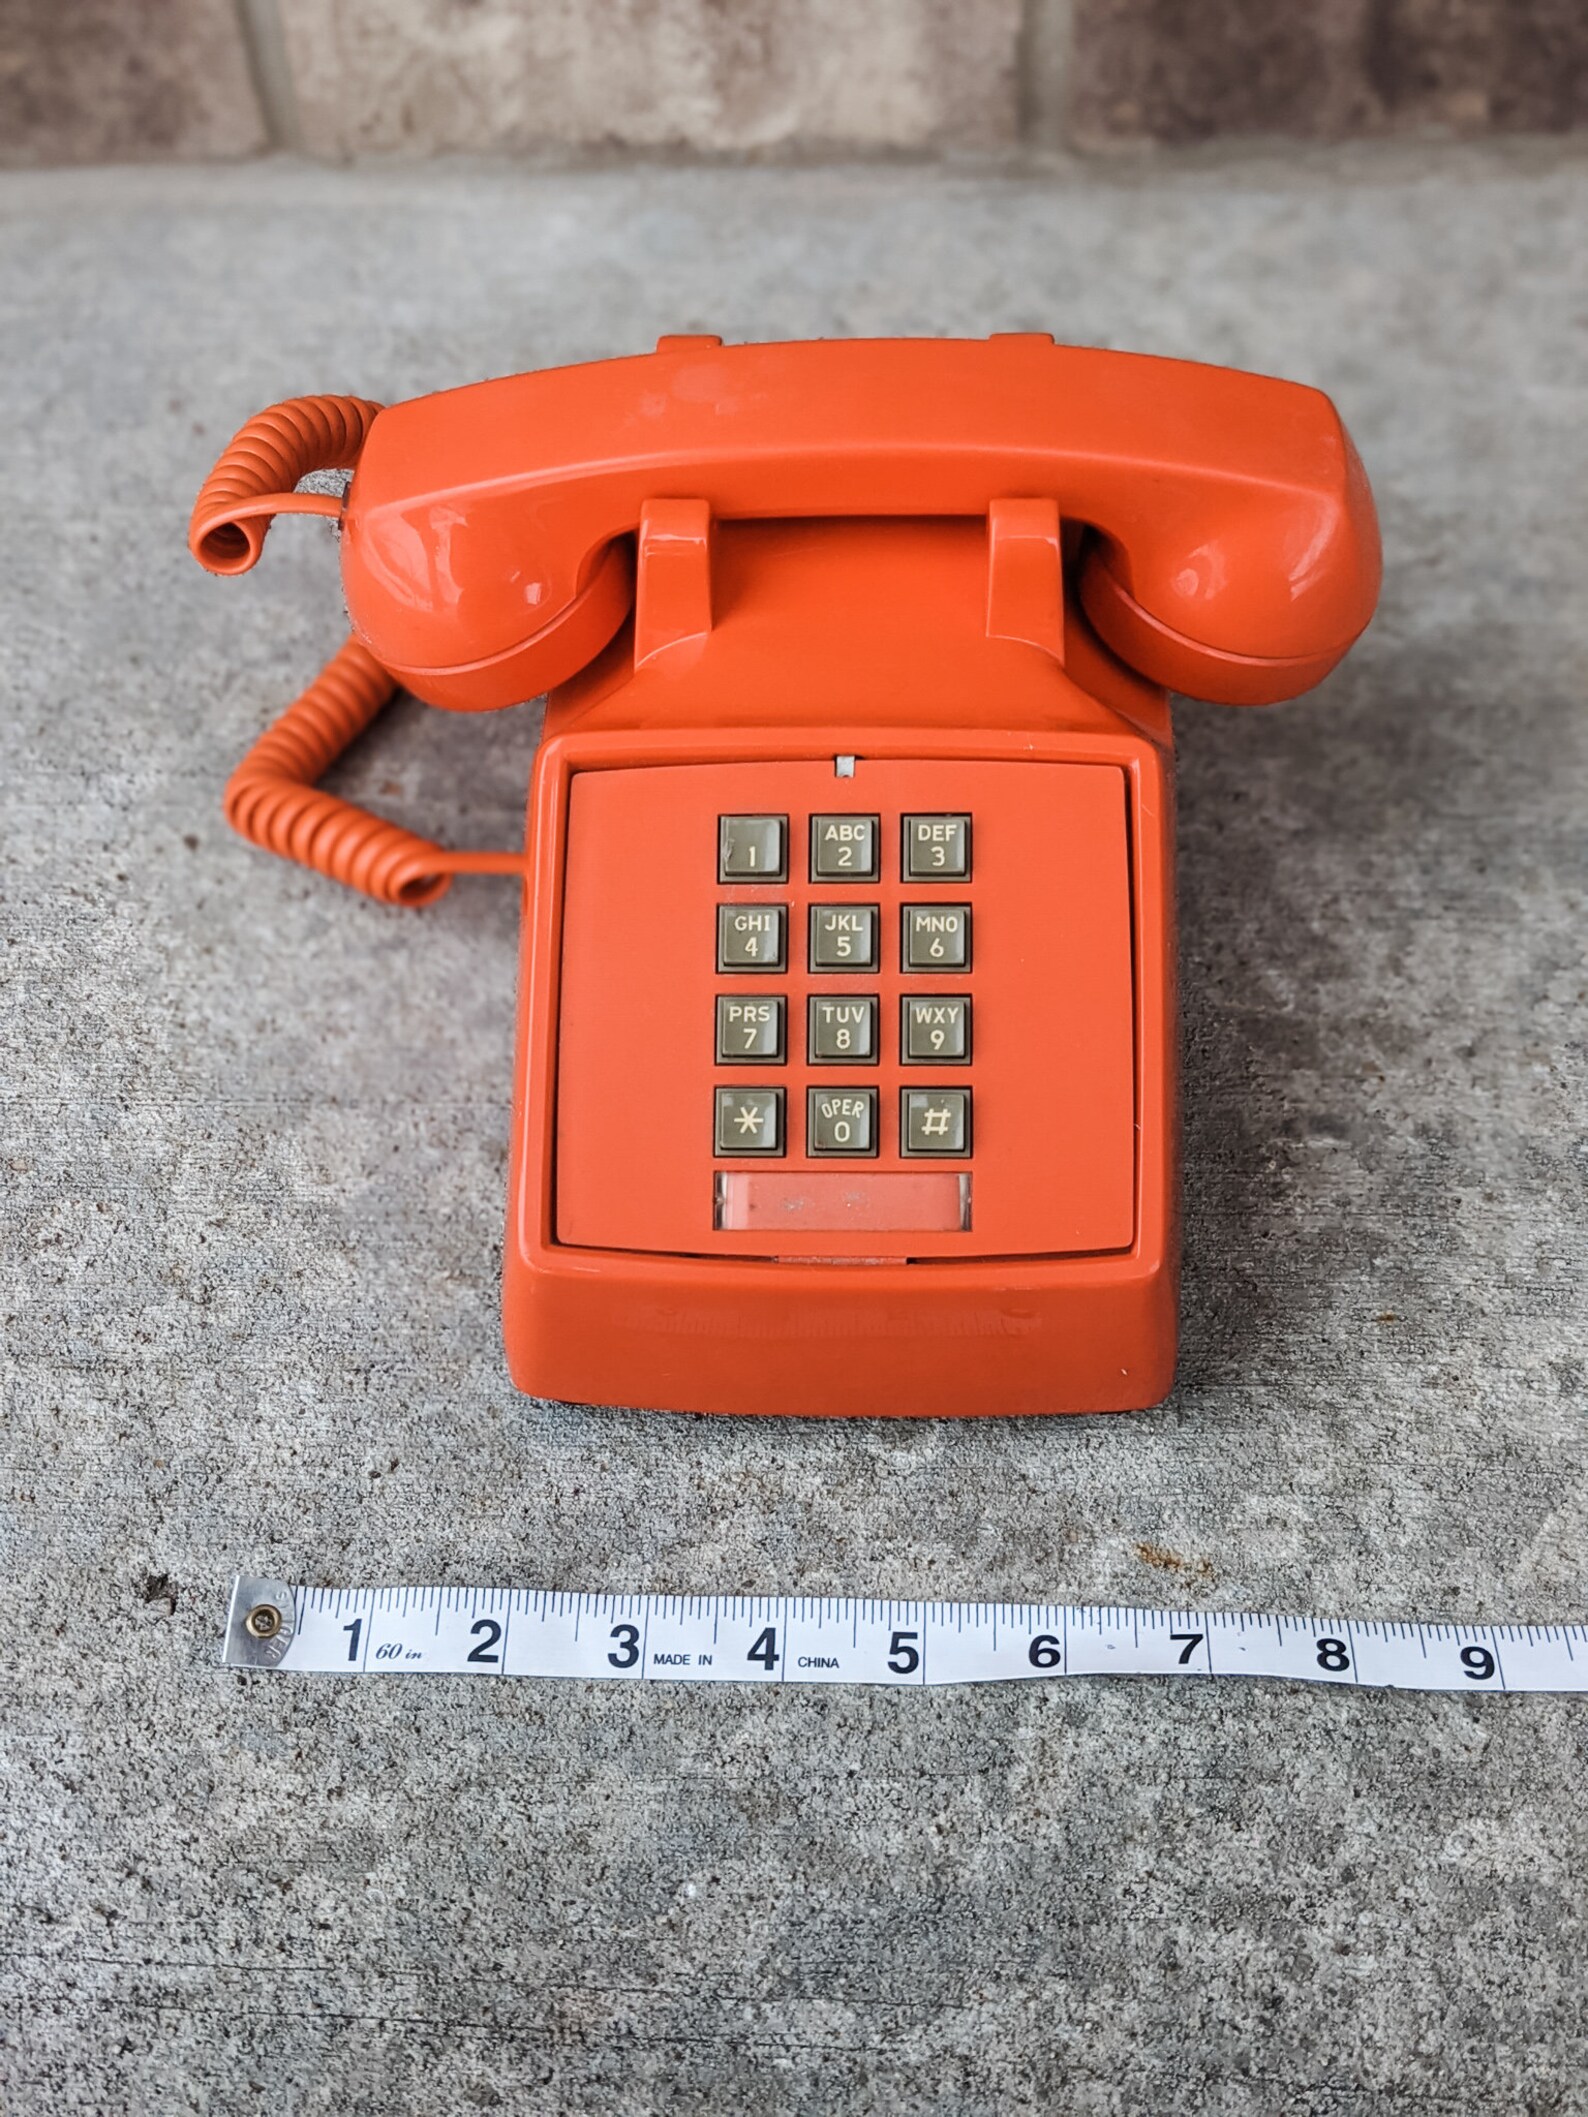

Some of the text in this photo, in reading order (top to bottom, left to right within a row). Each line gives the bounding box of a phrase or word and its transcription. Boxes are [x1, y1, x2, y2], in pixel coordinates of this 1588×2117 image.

[824, 823, 865, 842] ABC
[918, 824, 957, 842] DEF
[748, 846, 756, 867] 1
[837, 847, 852, 867] 2
[931, 846, 945, 867] 3
[734, 915, 770, 932] GHI
[825, 915, 863, 932] JKL
[916, 916, 957, 933] MNO
[744, 937, 759, 957] 4
[836, 936, 852, 957] 5
[930, 938, 945, 958] 6
[729, 1006, 770, 1023] PRS
[823, 1006, 865, 1024] TUV
[915, 1007, 959, 1024] WXY
[743, 1028, 757, 1050] 7
[836, 1029, 851, 1050] 8
[930, 1029, 945, 1051] 9
[821, 1099, 864, 1119] OPER
[921, 1108, 951, 1135] #
[343, 1618, 1496, 1680] 1 2 3 4 5 6 7 8 9
[375, 1643, 423, 1660] 60 in
[653, 1653, 840, 1669] MADE IN CHINA
